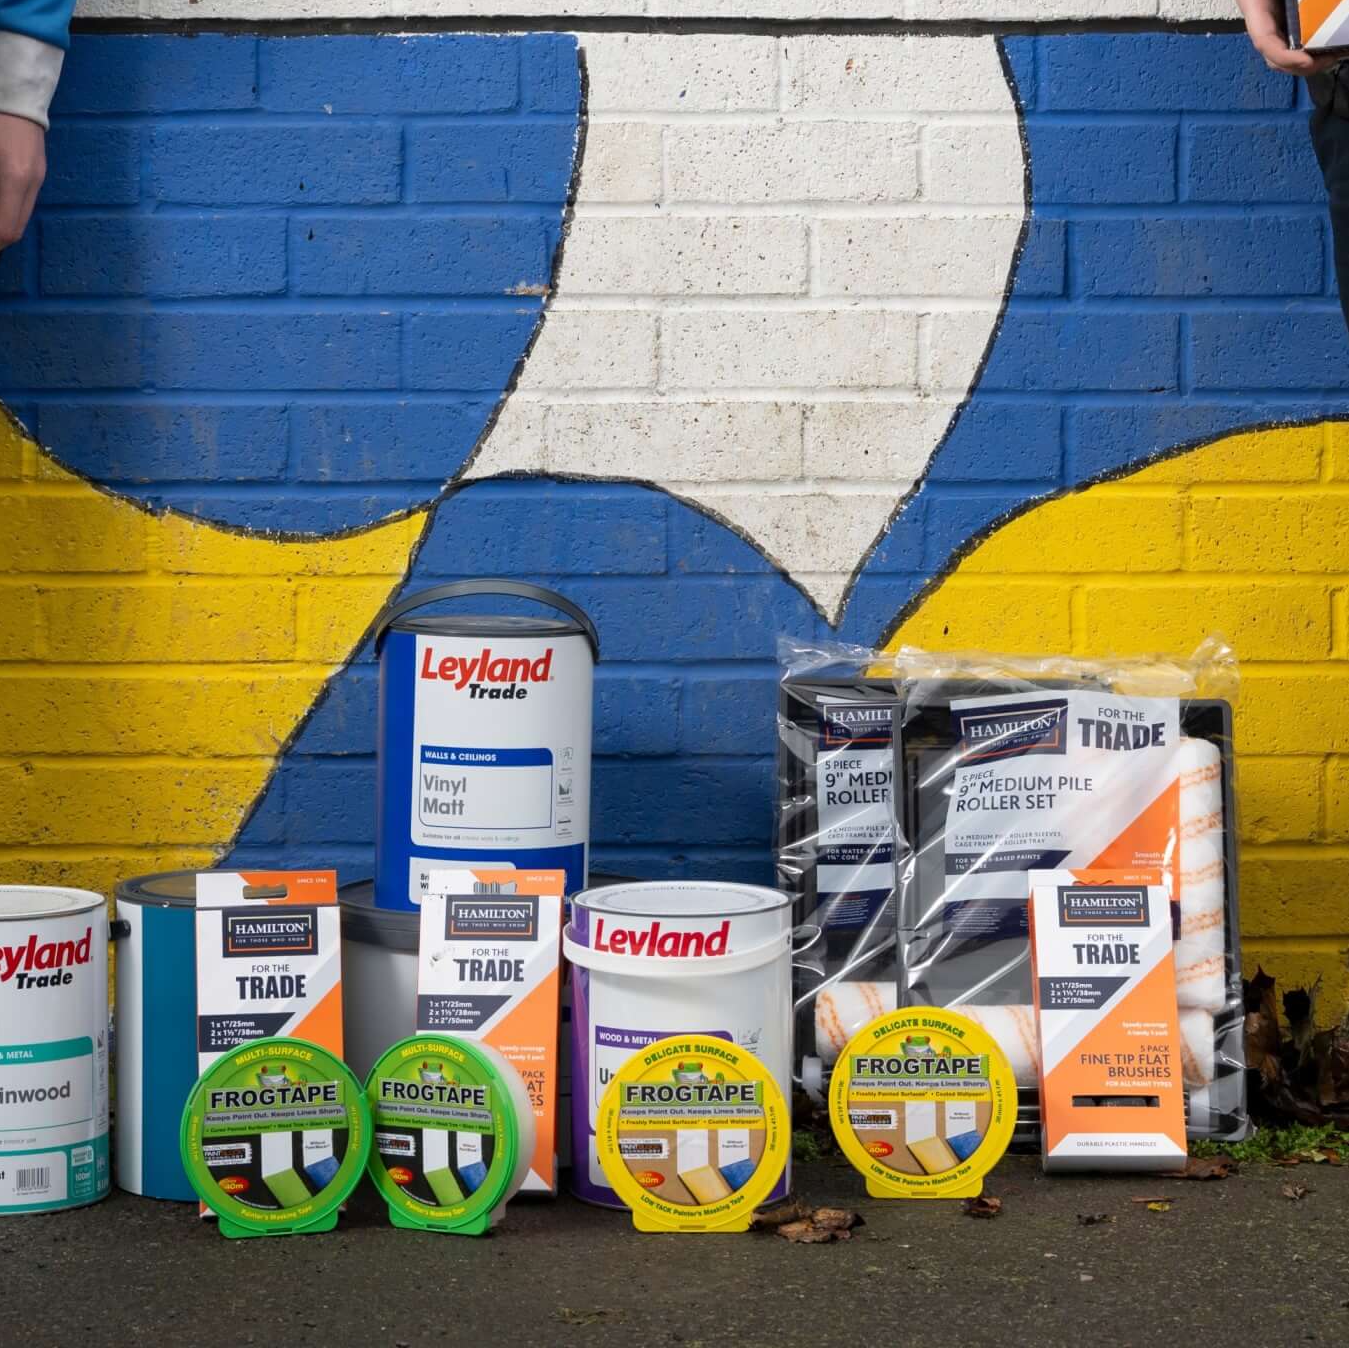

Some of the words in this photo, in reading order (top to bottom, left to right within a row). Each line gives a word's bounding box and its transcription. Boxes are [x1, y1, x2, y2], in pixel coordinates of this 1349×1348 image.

[421, 647, 554, 690] Leyland
[469, 684, 528, 700] Trade
[832, 710, 892, 722] HAMILT
[1098, 708, 1122, 718] FOR
[1124, 710, 1145, 721] THE
[970, 718, 1052, 738] HAMILTON
[1078, 718, 1165, 750] TRADE
[425, 751, 448, 760] WALLS
[450, 752, 456, 760] &
[458, 753, 497, 762] CEILINGS
[826, 761, 830, 770] 5
[834, 760, 862, 770] PIECE
[826, 772, 844, 787] 9"
[850, 772, 892, 786] MEDI
[962, 774, 968, 783] 5
[970, 770, 994, 782] PIECE
[423, 774, 467, 796] Vinyl
[960, 782, 976, 797] 9"
[980, 776, 1053, 794] MEDIUM
[1058, 777, 1093, 792] PILE
[423, 798, 464, 815] Matt
[956, 796, 1021, 812] ROLLER
[1026, 794, 1056, 809] SET
[1070, 898, 1136, 907] HAMILTON
[458, 909, 526, 919] HAMILTON
[236, 922, 305, 934] HAMILTON
[594, 918, 731, 958] Leyland
[1088, 934, 1104, 942] FOR
[1108, 934, 1124, 942] THE
[1072, 944, 1140, 964] TRADE
[252, 965, 270, 973] FOR
[272, 964, 290, 972] THE
[455, 959, 524, 982] TRADE
[16, 969, 73, 990] Trade
[236, 975, 306, 1000] TRADE
[211, 1020, 214, 1028] 1
[873, 1018, 919, 1039] DELICATE
[922, 1019, 966, 1039] SURFACE
[600, 1032, 622, 1042] WOOD
[624, 1034, 630, 1042] &
[6, 1051, 34, 1060] METAL
[235, 1046, 314, 1066] MULTI-SURFACE
[401, 1044, 465, 1062] MULTI-SURFACE
[644, 1044, 692, 1066] DELICATE
[694, 1044, 740, 1065] SURFACE
[1080, 1054, 1110, 1064] FINE
[1114, 1054, 1134, 1064] TIP
[1139, 1054, 1170, 1064] FLAT
[522, 1070, 545, 1078] PACK
[856, 1058, 980, 1074] FROGTAPE
[1108, 1067, 1171, 1078] BRUSHES
[382, 1081, 485, 1106] FROGTAPE
[526, 1080, 545, 1092] AT
[626, 1085, 754, 1102] FROGTAPE
[211, 1085, 336, 1108] FROGTAPE
